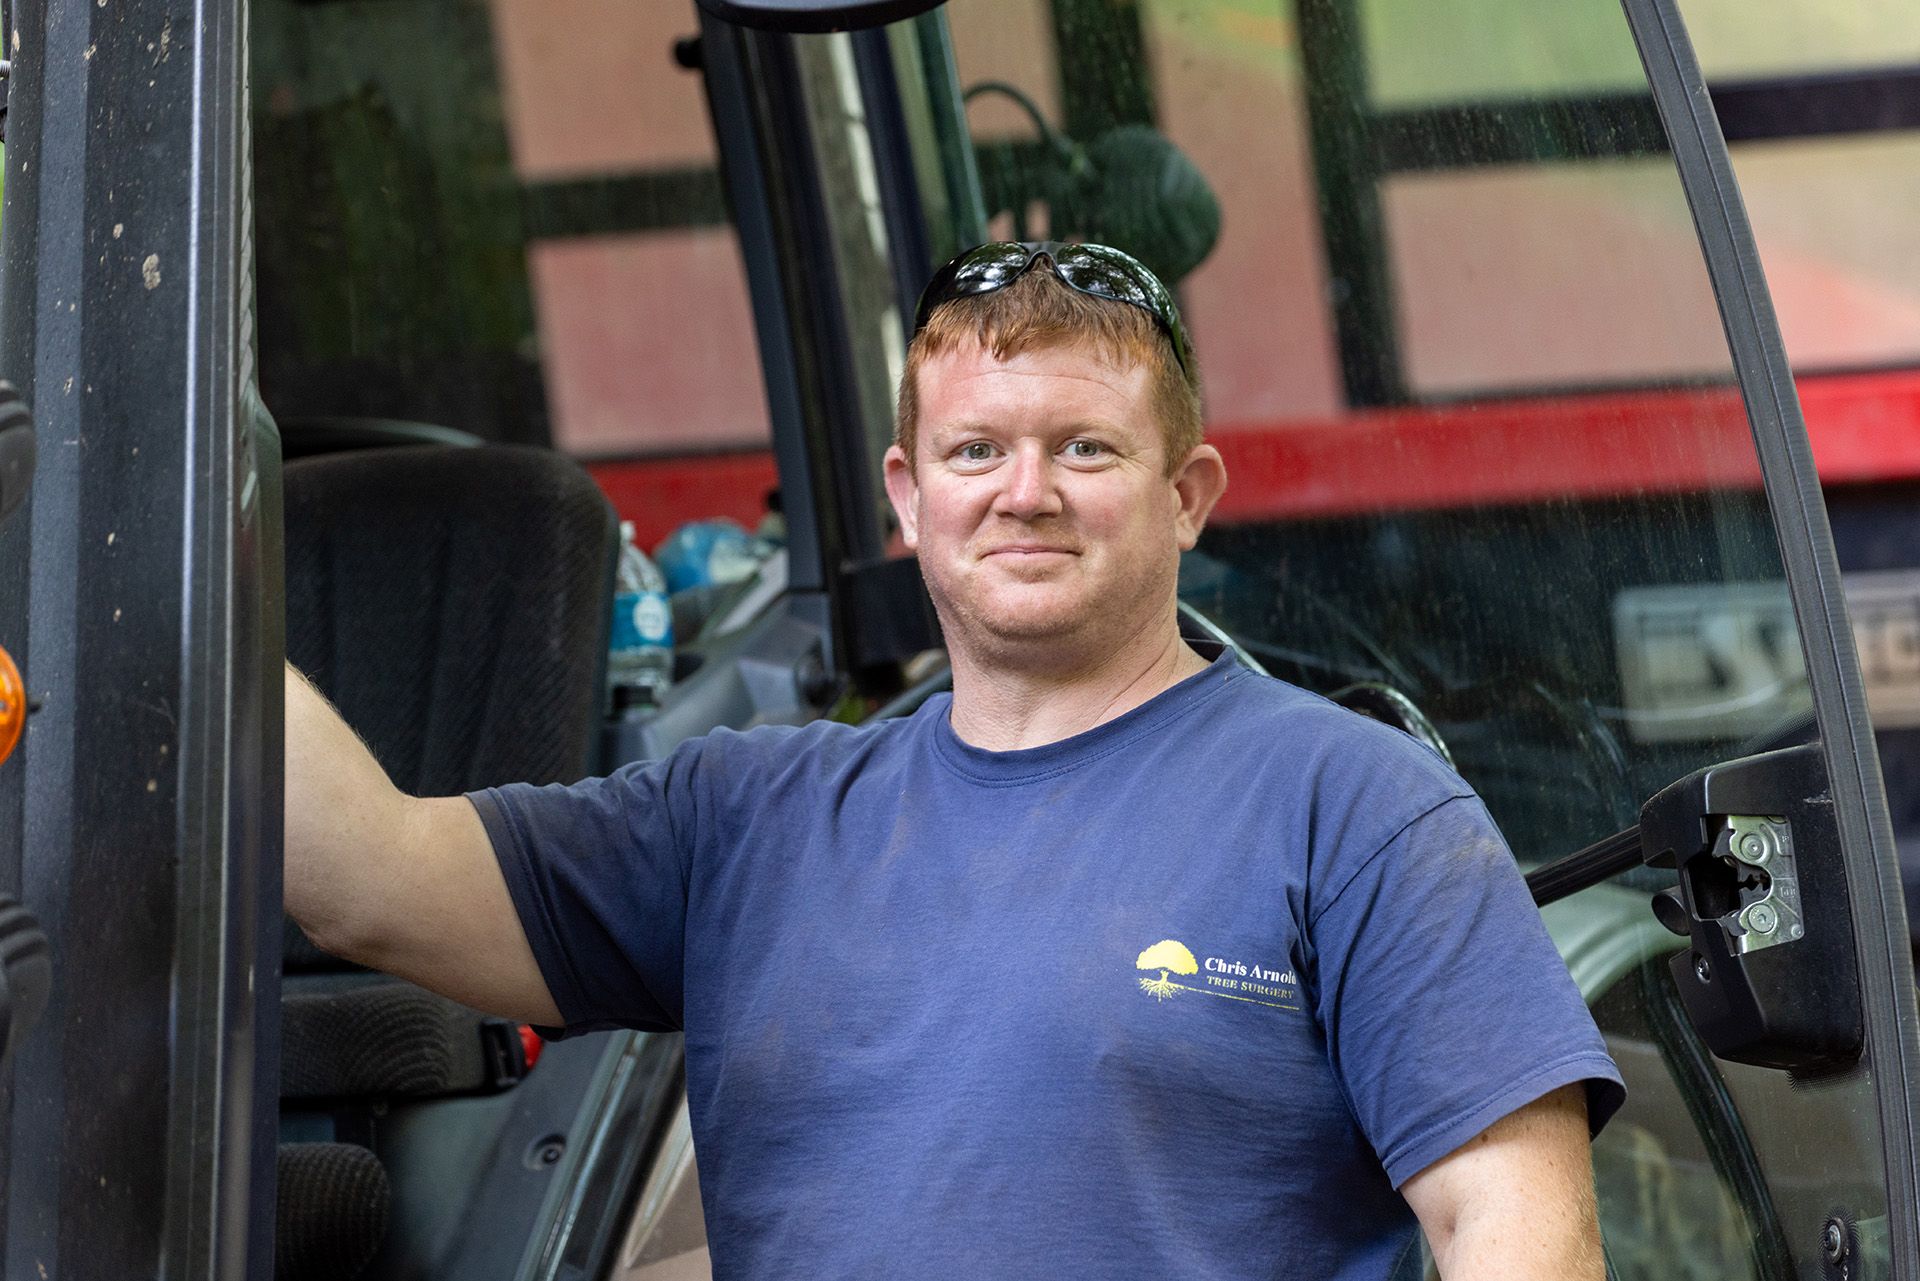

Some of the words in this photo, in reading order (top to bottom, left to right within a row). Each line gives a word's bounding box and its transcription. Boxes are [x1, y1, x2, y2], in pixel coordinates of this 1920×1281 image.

[1205, 957, 1247, 976] Chris
[1206, 975, 1238, 989] TREE
[1241, 981, 1294, 999] SURGERY
